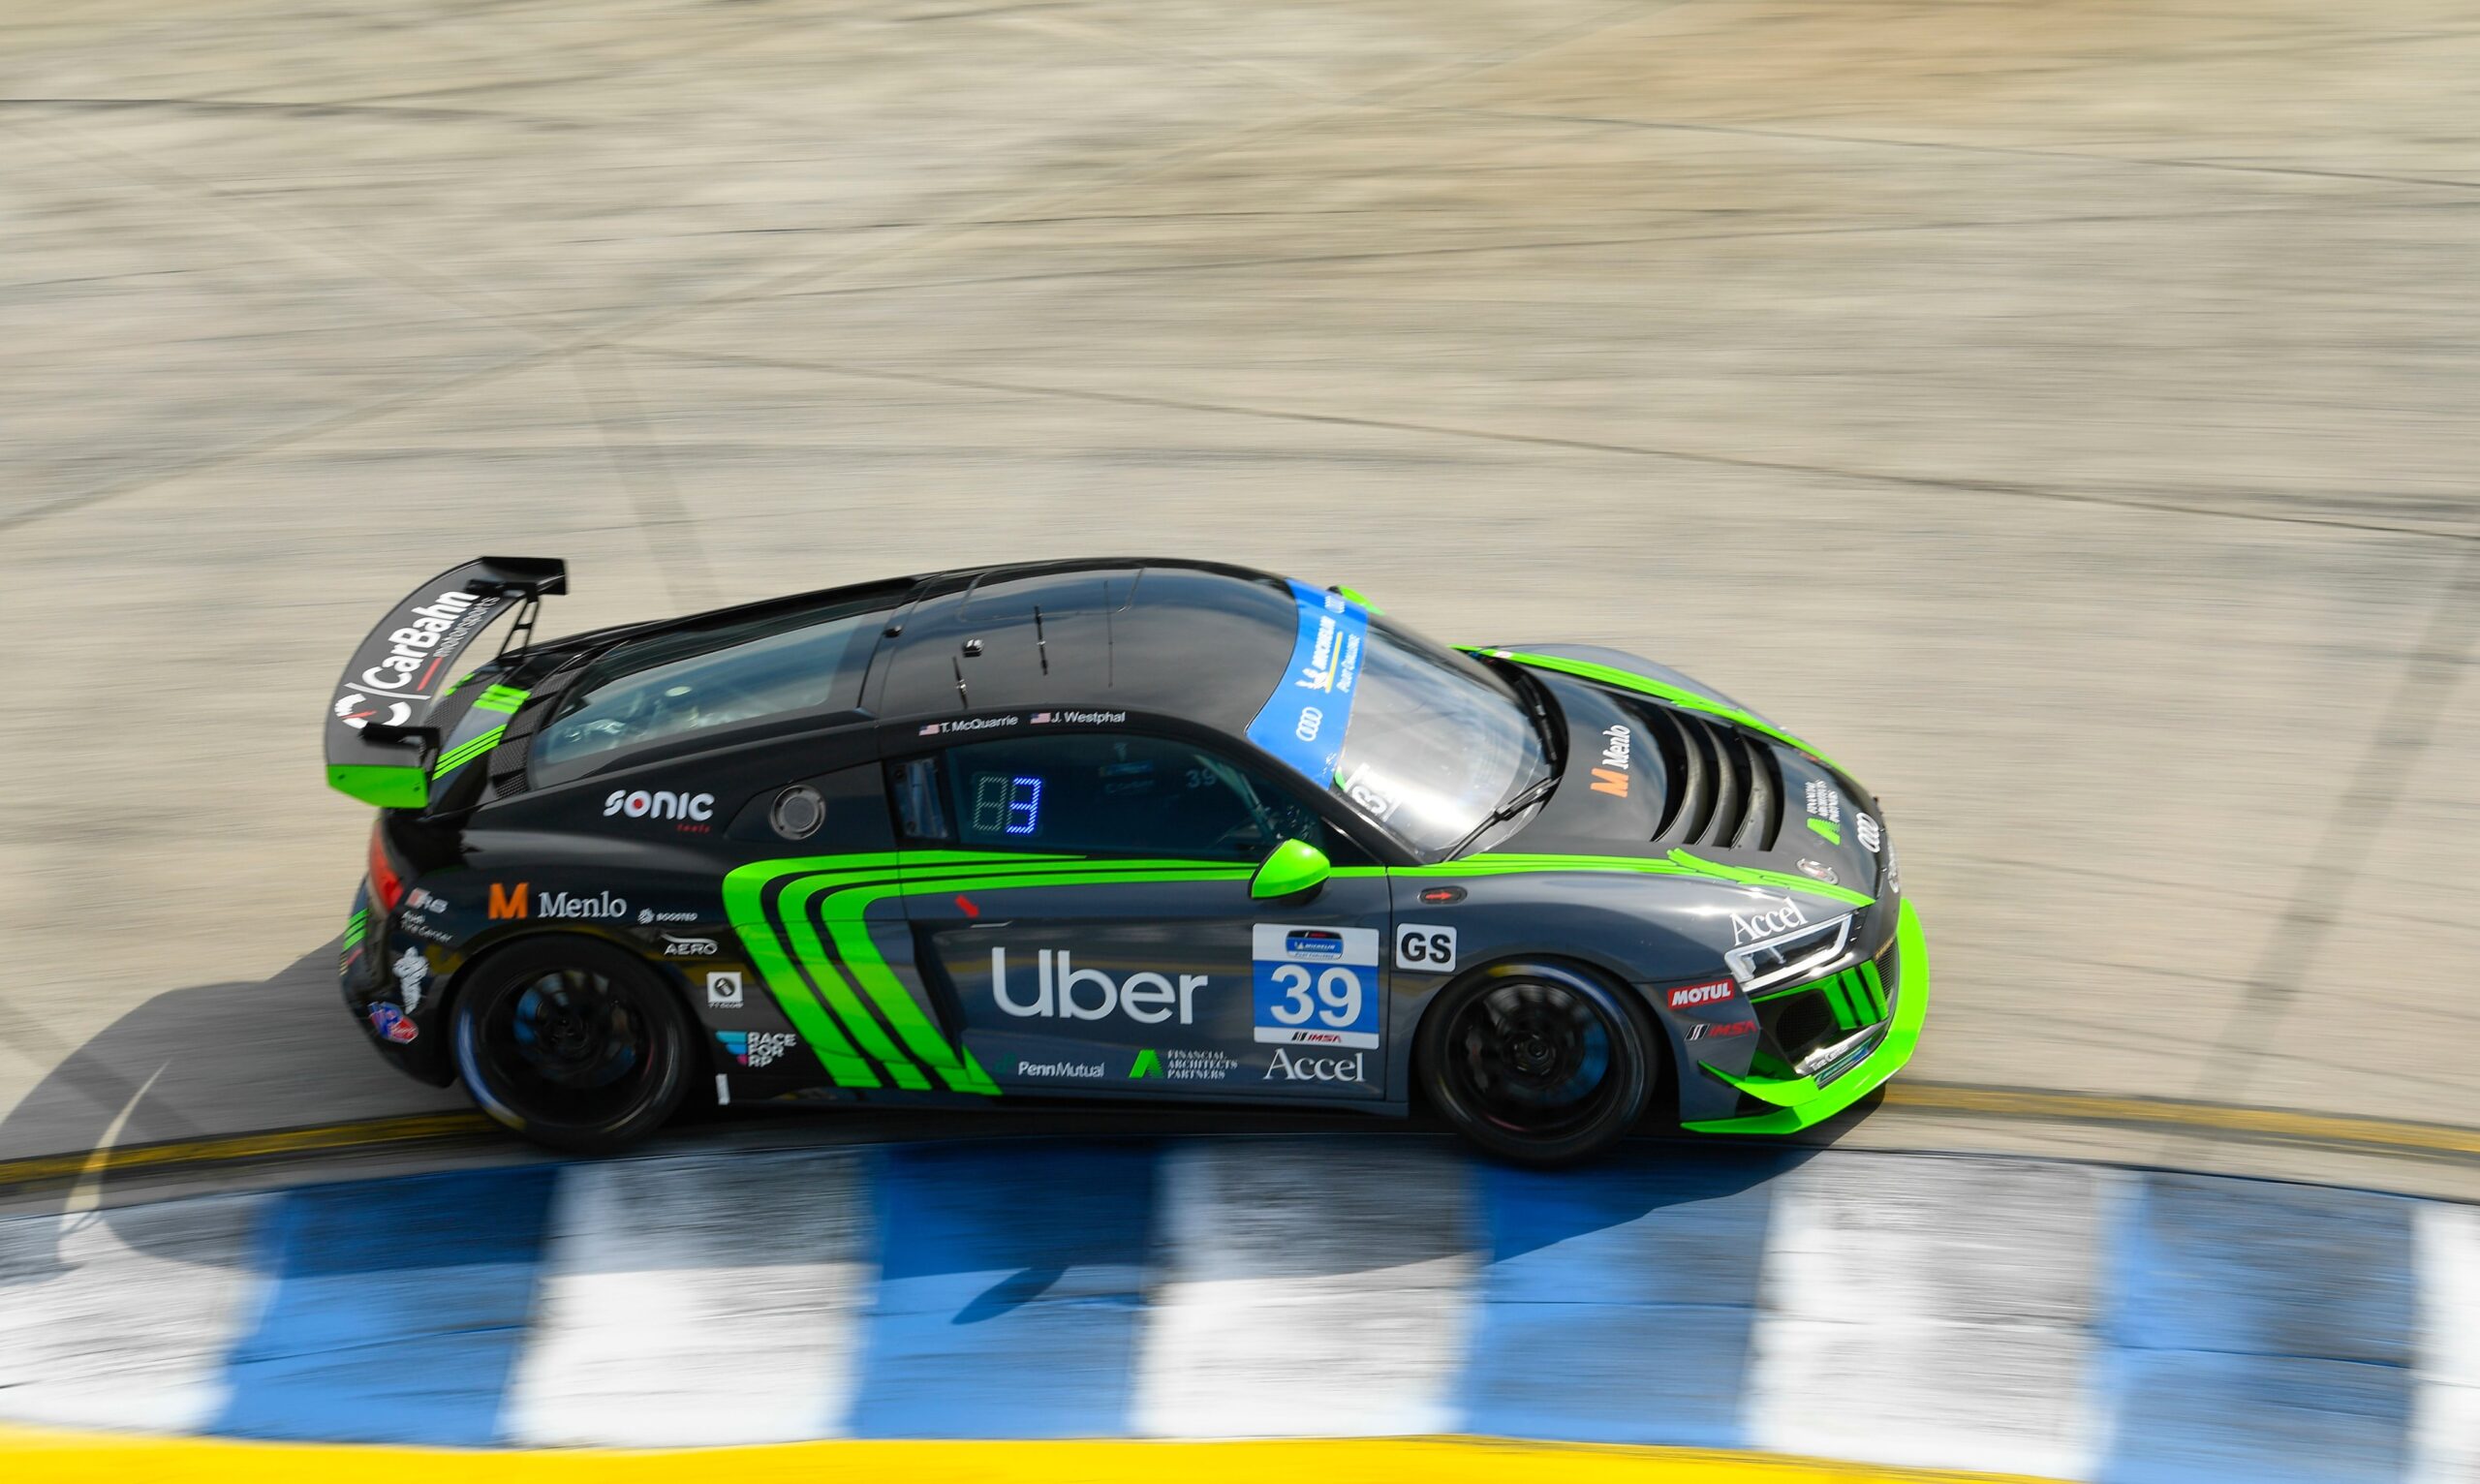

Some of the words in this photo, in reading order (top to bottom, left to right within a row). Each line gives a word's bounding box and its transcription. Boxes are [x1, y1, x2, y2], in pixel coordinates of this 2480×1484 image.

[361, 590, 480, 689] CarBahn
[951, 715, 1018, 731] McQuarrie
[1050, 712, 1062, 724] J.
[1065, 711, 1126, 725] Westphal
[1602, 725, 1630, 769] Menlo
[538, 890, 628, 919] Menlo
[1730, 897, 1809, 946] Accel
[663, 943, 718, 955] AERO
[1401, 932, 1451, 963] GS
[991, 946, 1208, 1025] Uber
[1270, 964, 1362, 1028] 39
[1672, 982, 1731, 1006] MOTUL
[1708, 1022, 1757, 1036] IMSA
[747, 1031, 796, 1046] RACE
[1307, 1034, 1342, 1043] IMSA
[747, 1043, 784, 1057] FOR
[1166, 1049, 1226, 1060] FINANCIAL
[747, 1055, 772, 1067] RP
[1166, 1059, 1238, 1069] ARCHITECTS
[1262, 1048, 1366, 1082] Accel
[1018, 1061, 1104, 1078] PennMutual
[1166, 1068, 1225, 1079] PARTNERS
